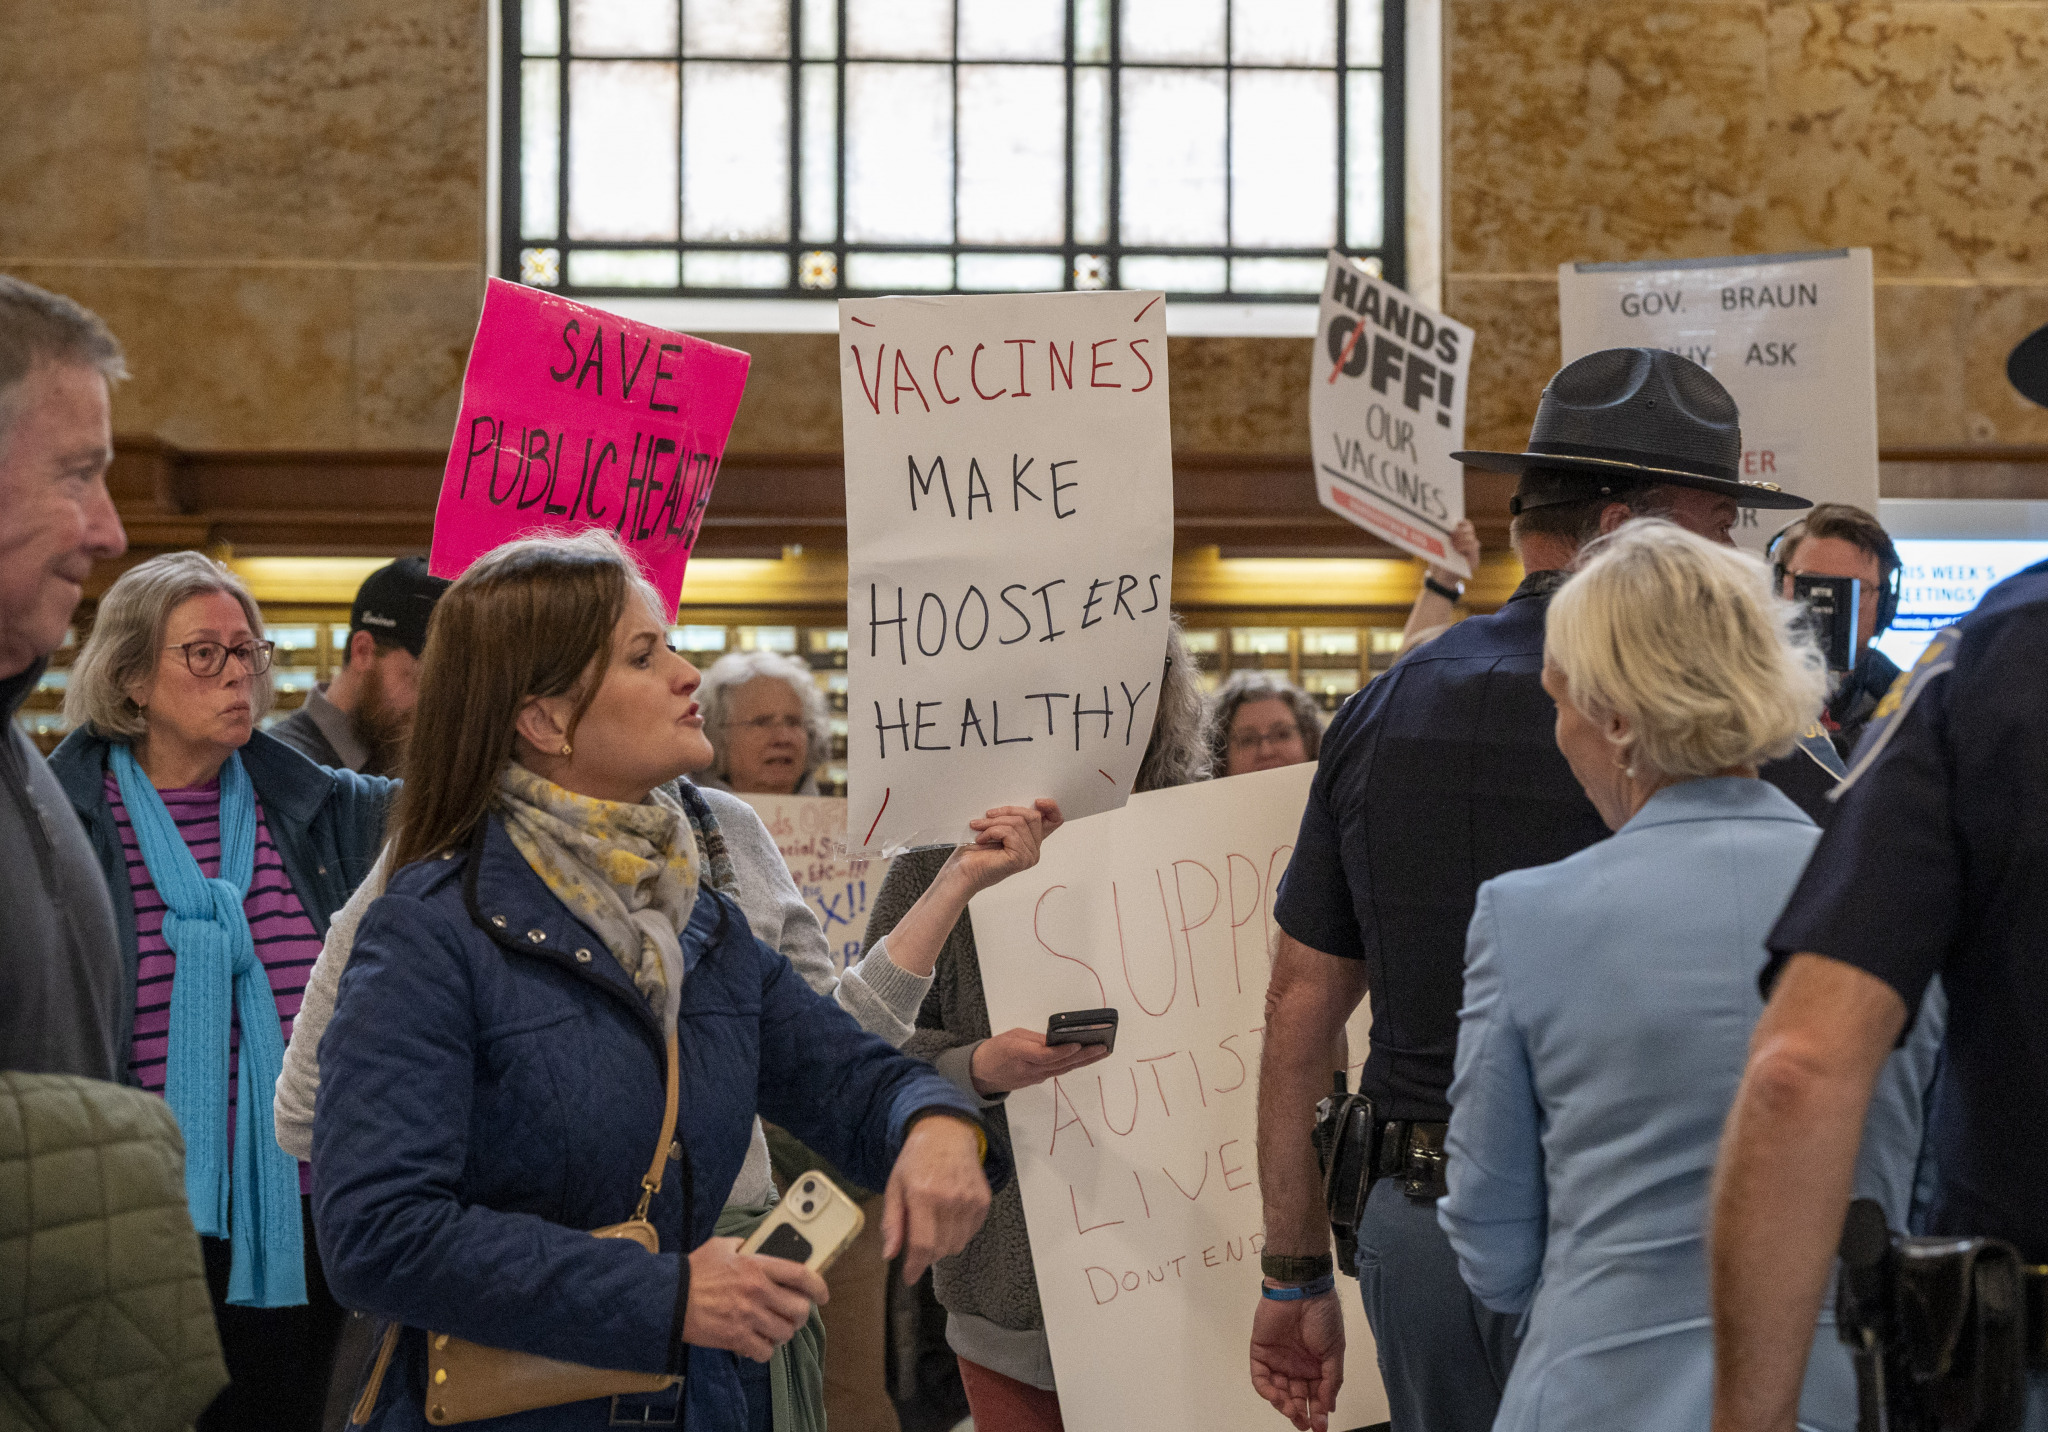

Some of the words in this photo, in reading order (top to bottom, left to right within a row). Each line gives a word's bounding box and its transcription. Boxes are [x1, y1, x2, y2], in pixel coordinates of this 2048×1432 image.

[1332, 265, 1459, 365] HANDS
[1620, 289, 1686, 317] GOV.
[1720, 283, 1818, 311] BRAUN
[550, 318, 683, 414] SAVE
[851, 338, 1153, 415] VACCINES
[1327, 315, 1455, 429] OFF!
[1744, 342, 1798, 367] ASK
[459, 415, 617, 521] PUBLIC
[1333, 431, 1448, 521] VACCINES
[1366, 402, 1419, 466] OUR
[1741, 449, 1777, 475] ER
[907, 453, 1078, 521] MAKE
[869, 573, 1161, 665] HOOSIERS
[874, 681, 1151, 759] HEALTHY
[1070, 1139, 1251, 1235] LIVE
